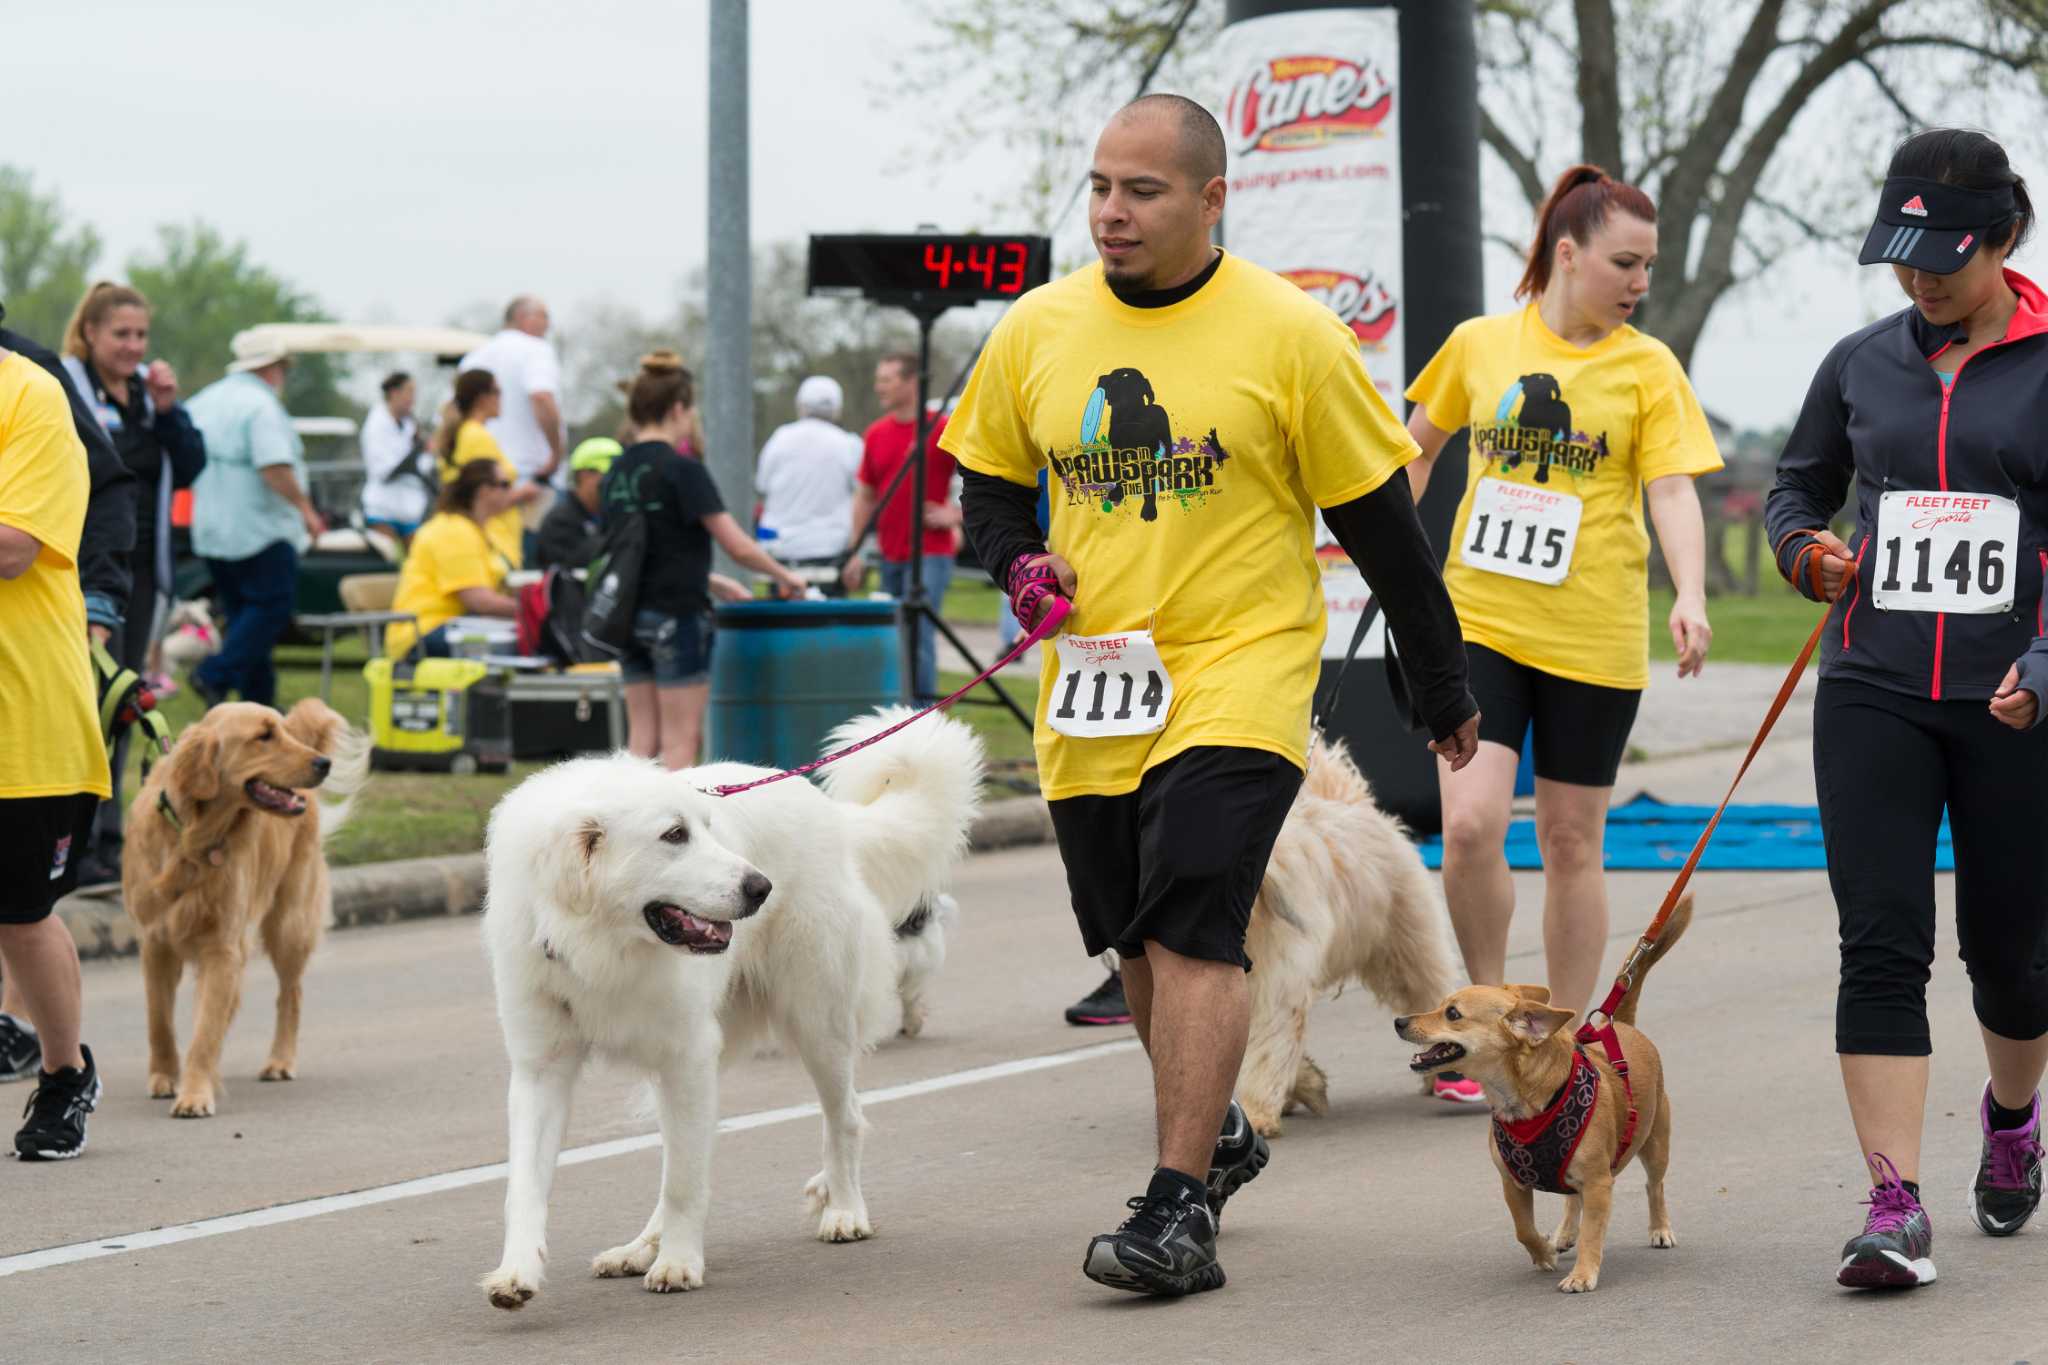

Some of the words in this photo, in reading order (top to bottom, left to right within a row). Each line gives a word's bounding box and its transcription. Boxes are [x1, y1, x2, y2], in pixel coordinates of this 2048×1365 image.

[1060, 447, 1141, 485] PAWS
[1540, 441, 1599, 473] PARK
[1141, 455, 1214, 494] PARK
[1497, 484, 1533, 498] FLEET
[1533, 492, 1562, 506] FEET
[1906, 496, 1950, 508] FLEET
[1952, 498, 1991, 511] FEET
[1912, 510, 1975, 531] Sports
[1470, 513, 1566, 568] 1115
[1881, 536, 2005, 596] 1146
[1068, 639, 1098, 650] FLEET
[1099, 637, 1129, 650] FEET
[1085, 650, 1125, 666] Sports
[1056, 669, 1164, 721] 1114
